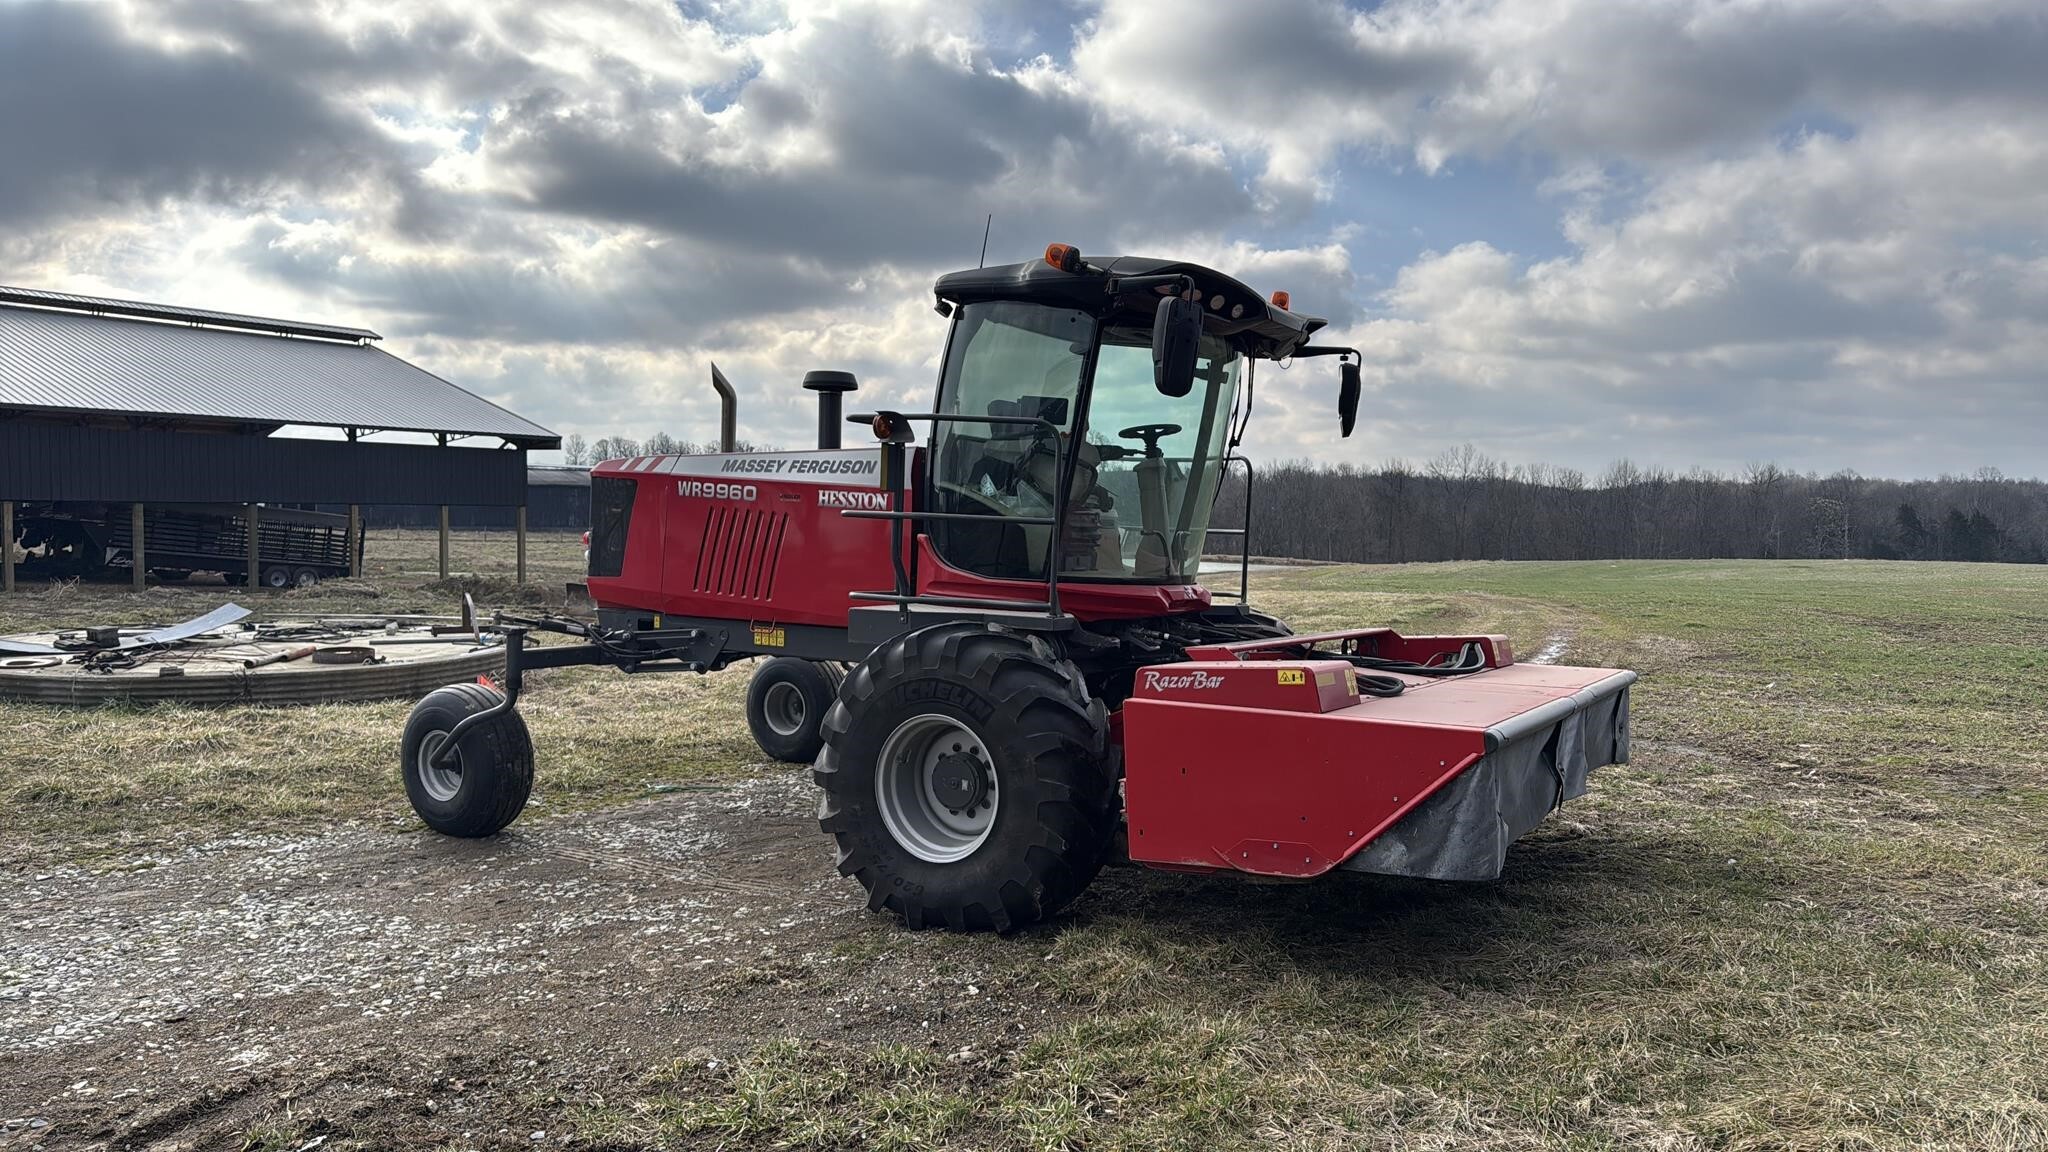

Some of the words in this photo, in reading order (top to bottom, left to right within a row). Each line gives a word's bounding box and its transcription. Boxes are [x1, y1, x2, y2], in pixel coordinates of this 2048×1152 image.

[721, 459, 786, 473] MASSEY
[788, 460, 878, 474] FERGUSON
[678, 481, 757, 501] WR9960
[817, 489, 888, 510] HESSTON
[1144, 671, 1224, 692] RazorBar
